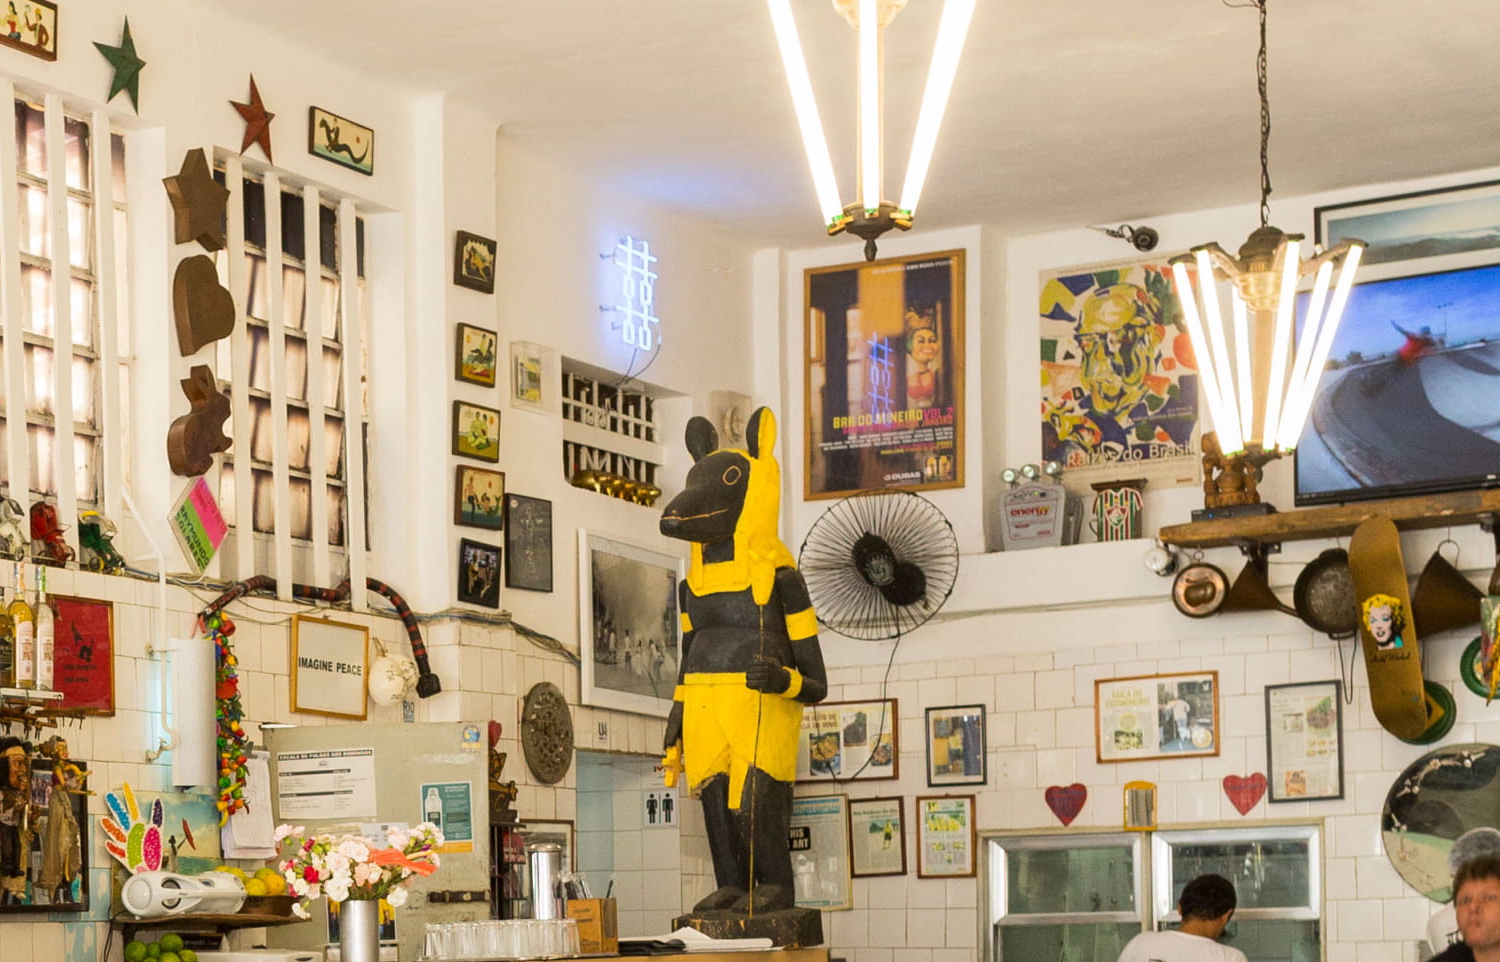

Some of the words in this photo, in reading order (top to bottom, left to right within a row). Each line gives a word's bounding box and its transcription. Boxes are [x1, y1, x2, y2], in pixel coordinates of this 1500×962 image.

[833, 417, 855, 429] BAR
[858, 414, 872, 426] DO
[1122, 444, 1143, 460] do
[298, 657, 333, 672] IMAGINE
[336, 662, 362, 676] PEACE
